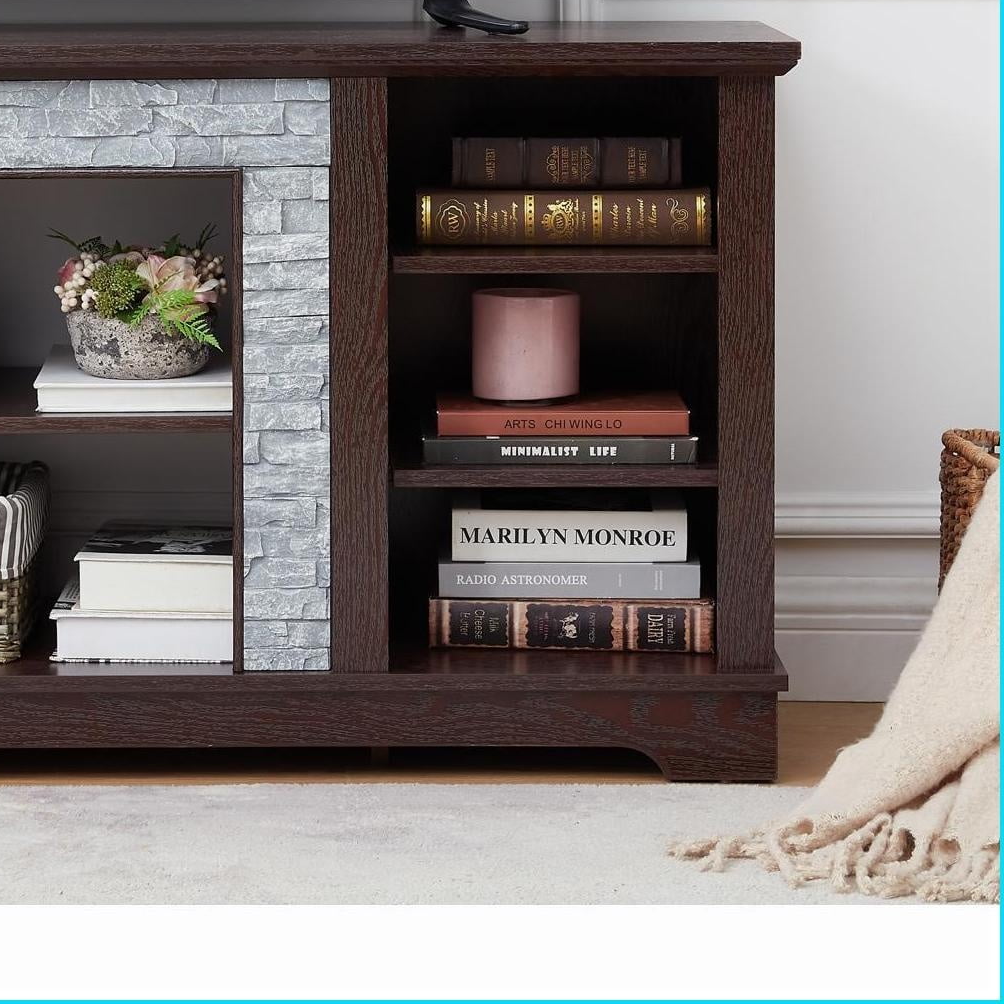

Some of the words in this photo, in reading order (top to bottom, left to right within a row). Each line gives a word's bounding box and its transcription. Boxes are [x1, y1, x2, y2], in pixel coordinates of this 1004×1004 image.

[448, 212, 460, 233] RW
[504, 419, 536, 429] ARTS
[545, 419, 566, 429] CHI
[570, 419, 603, 429] WING
[606, 419, 622, 429] LO
[500, 446, 580, 457] MINIMALIST
[589, 446, 618, 457] LIFE
[459, 527, 567, 545] MARILYN
[573, 528, 676, 547] MONROE
[456, 574, 497, 585] RADIO
[501, 574, 588, 585] ASTRONOMER
[474, 609, 486, 640] Cheese
[647, 613, 664, 644] DAIRY
